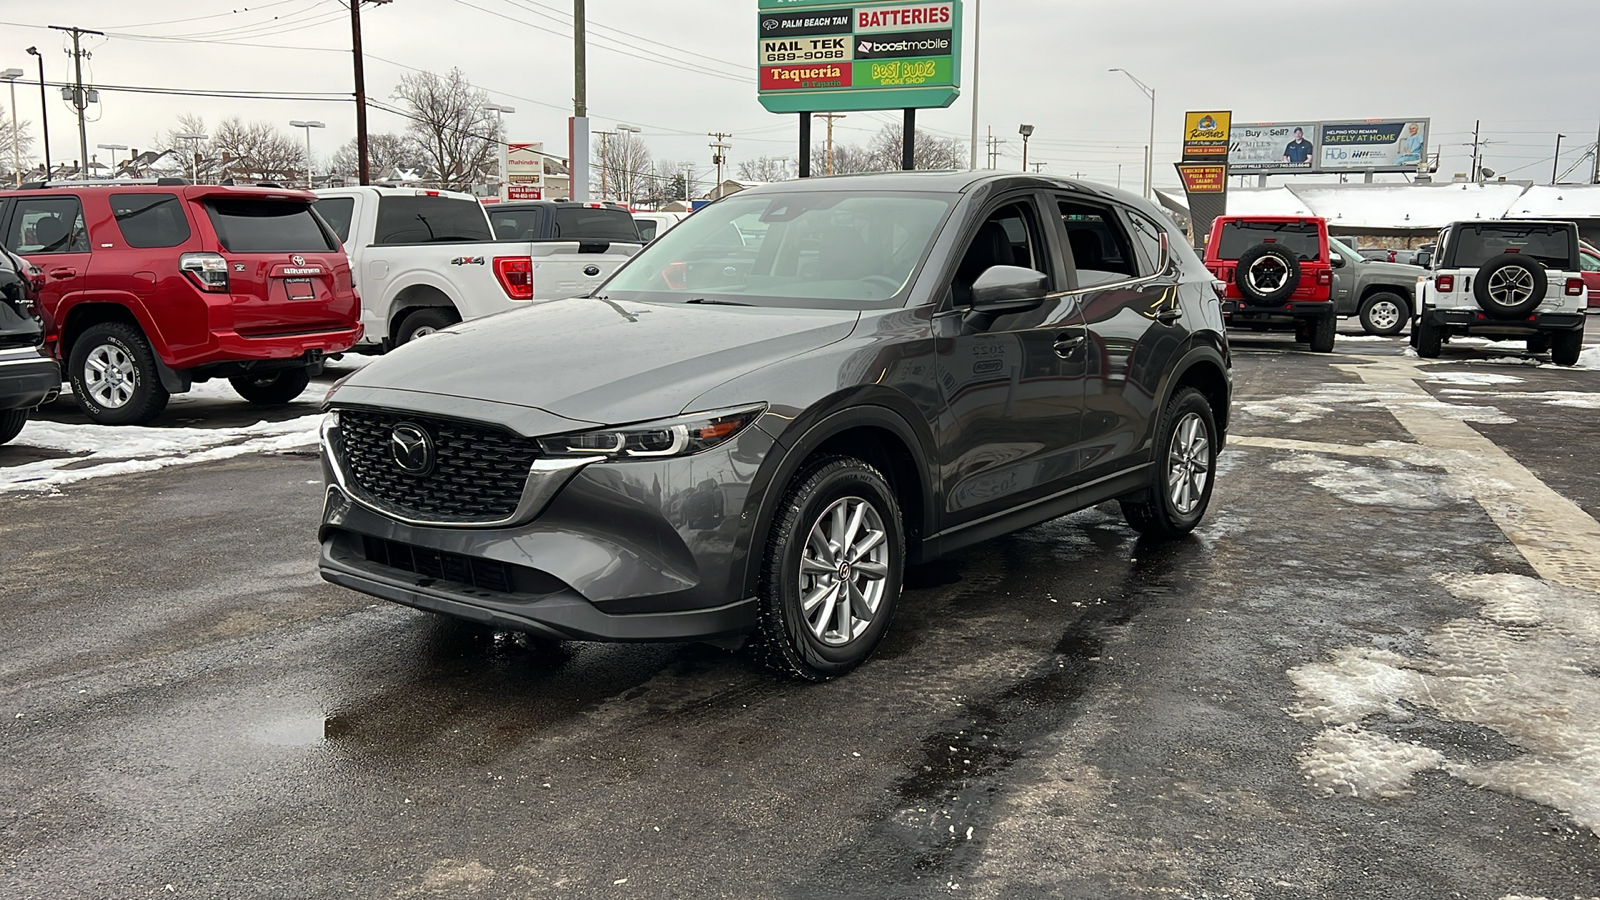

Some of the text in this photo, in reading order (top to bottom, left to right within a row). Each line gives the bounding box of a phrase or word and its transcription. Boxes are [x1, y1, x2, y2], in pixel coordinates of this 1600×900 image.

[781, 16, 848, 28] PALM BEACH TAN
[859, 6, 950, 28] BATTERIES
[765, 38, 845, 52] NAIL TEK
[767, 50, 844, 62] 689-9088
[902, 61, 936, 78] BUDZ
[1245, 130, 1262, 138] Buy
[1270, 128, 1289, 136] Sell?
[1370, 134, 1395, 142] HOME
